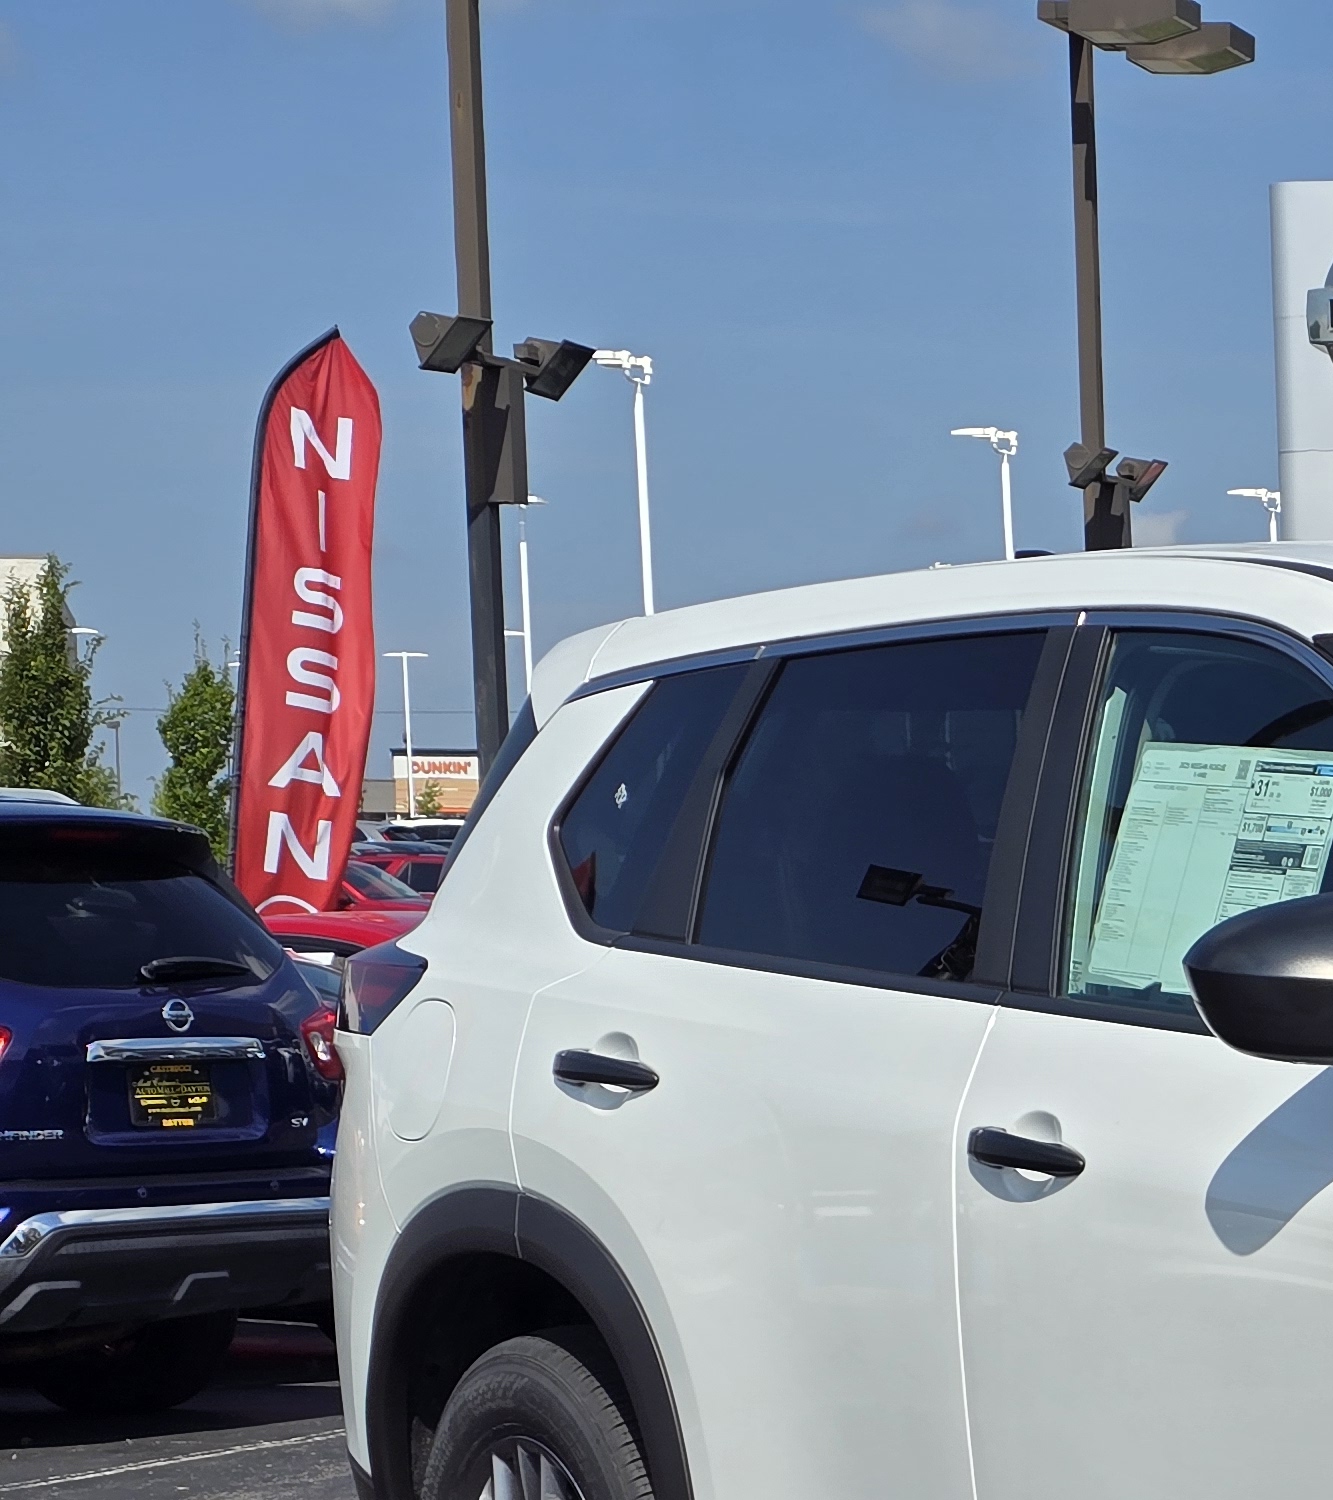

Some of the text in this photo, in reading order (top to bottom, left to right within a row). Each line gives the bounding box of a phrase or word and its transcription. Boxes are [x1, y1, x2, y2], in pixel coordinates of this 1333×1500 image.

[263, 405, 352, 881] NISSAN
[411, 761, 471, 774] DUNKIN'
[1254, 779, 1270, 798] 31
[290, 1117, 309, 1128] SV
